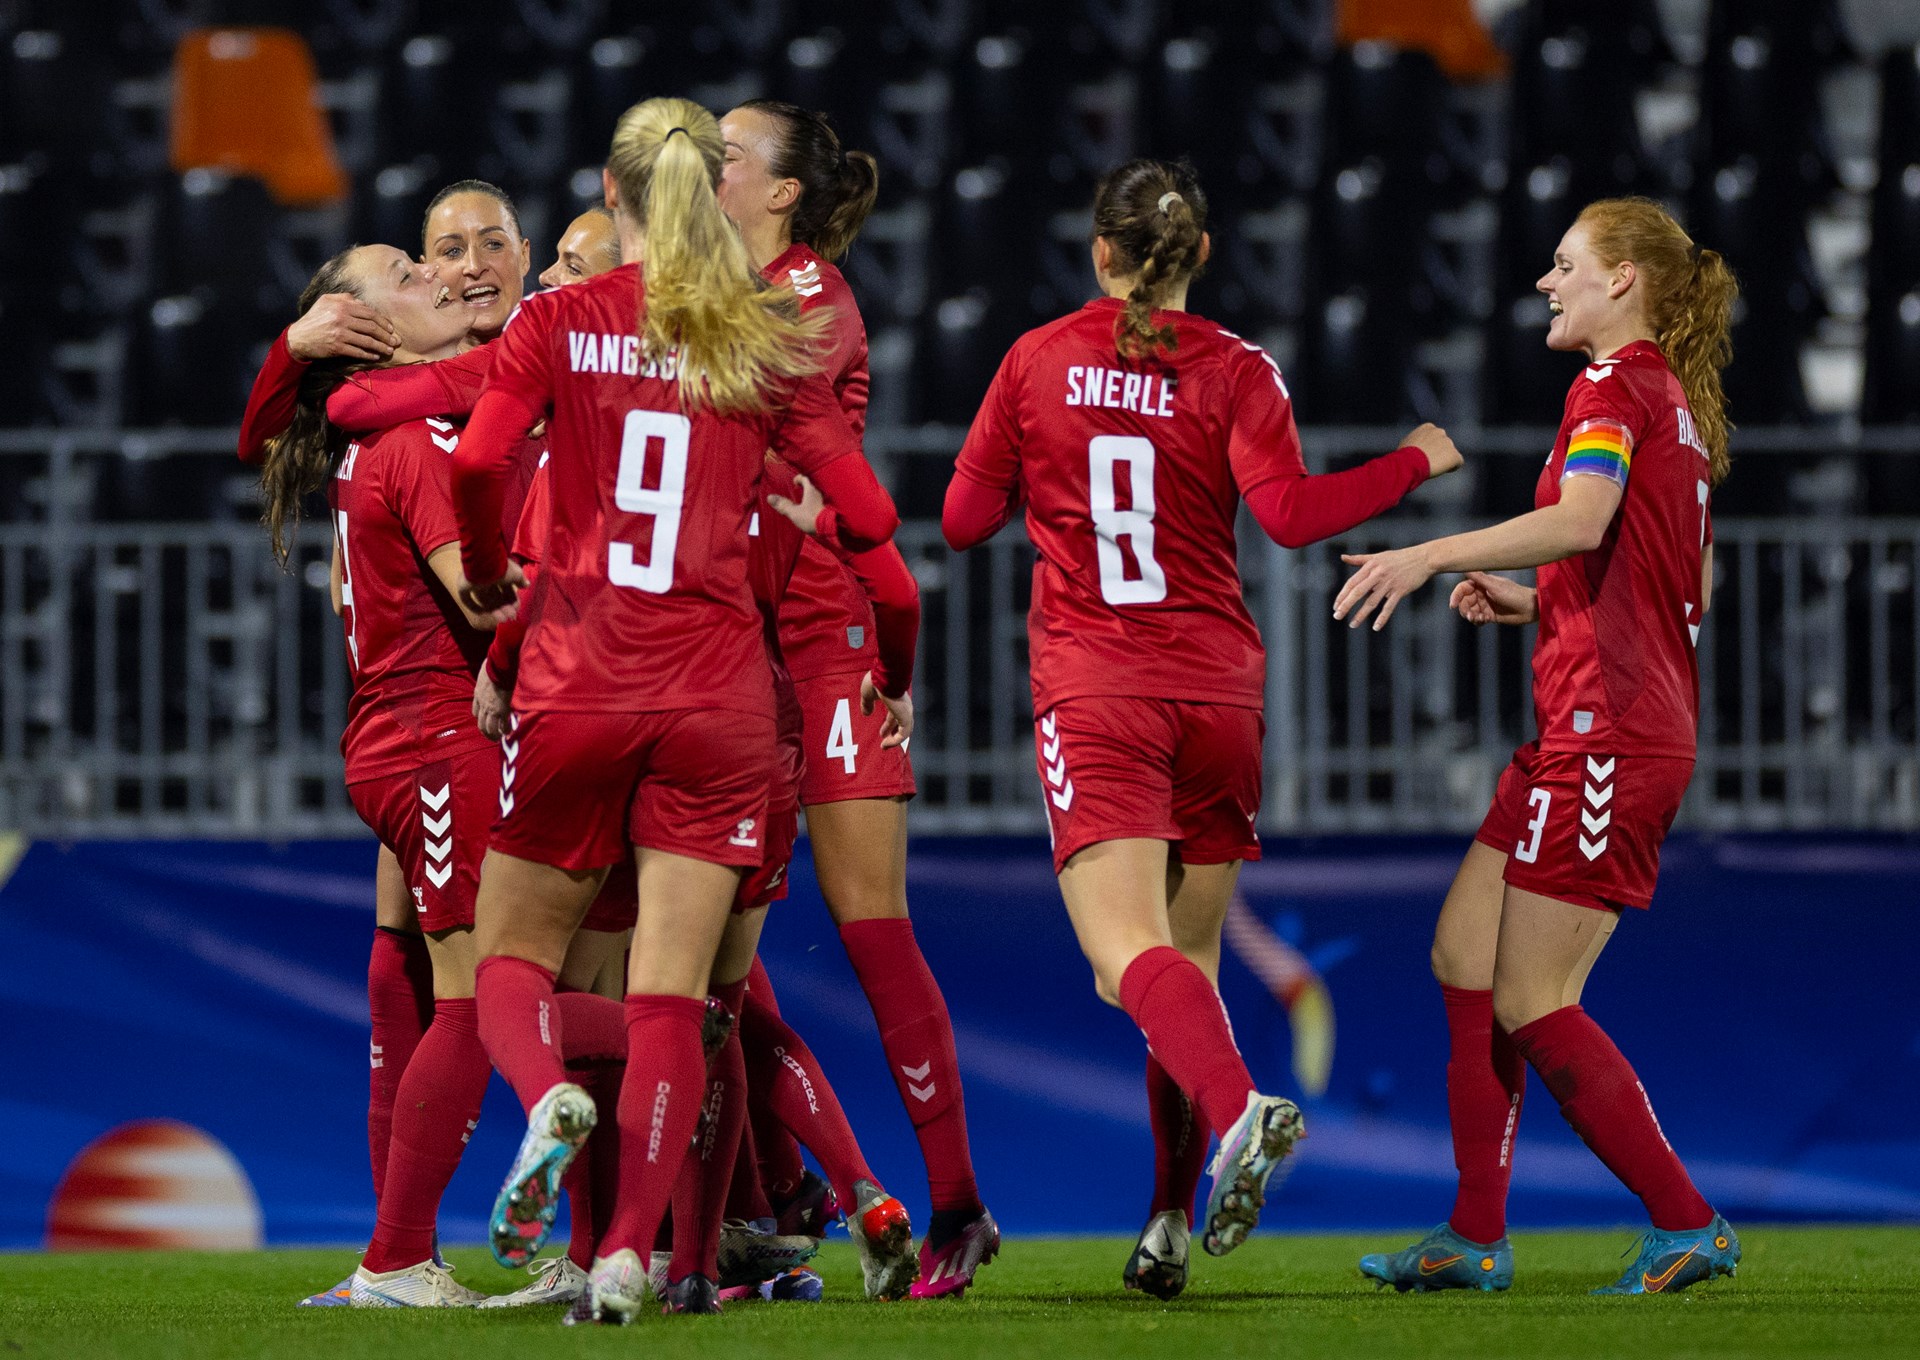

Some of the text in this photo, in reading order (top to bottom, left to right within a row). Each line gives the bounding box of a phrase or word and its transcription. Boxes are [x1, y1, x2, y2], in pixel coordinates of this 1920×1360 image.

[1066, 366, 1178, 417] SNERLE
[608, 409, 691, 594] 9
[1089, 435, 1168, 605] 8
[826, 698, 859, 774] 4
[1515, 787, 1551, 864] 3
[774, 1046, 820, 1115] DANMARK
[647, 1081, 671, 1164] DANMARK
[1499, 1093, 1520, 1167] DANMARK
